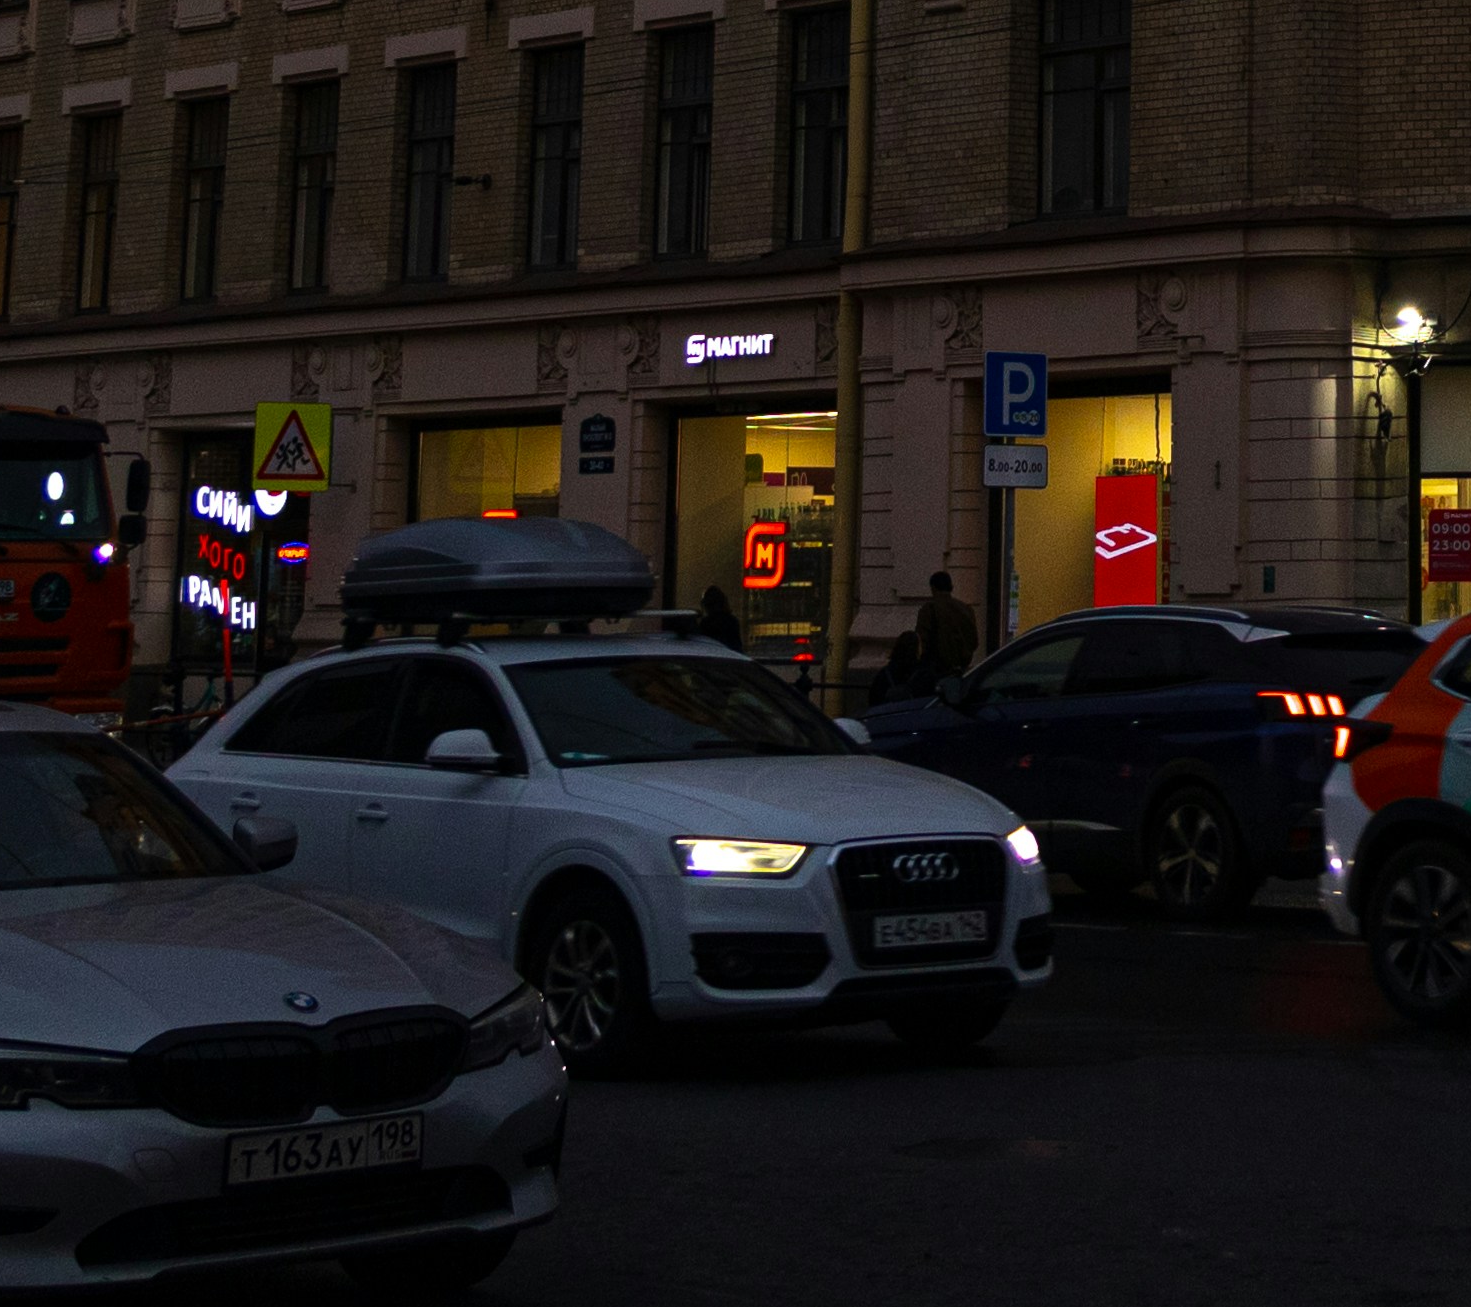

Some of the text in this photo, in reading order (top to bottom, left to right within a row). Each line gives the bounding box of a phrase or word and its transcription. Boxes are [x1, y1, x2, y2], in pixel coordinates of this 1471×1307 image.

[707, 334, 774, 357] МАГНИТ
[1002, 361, 1035, 426] P
[988, 459, 1043, 473] 8.00-20.00
[1432, 522, 1471, 534] 09:00
[1432, 539, 1471, 551] 23:00
[241, 1120, 414, 1179] Т163АУ 198
